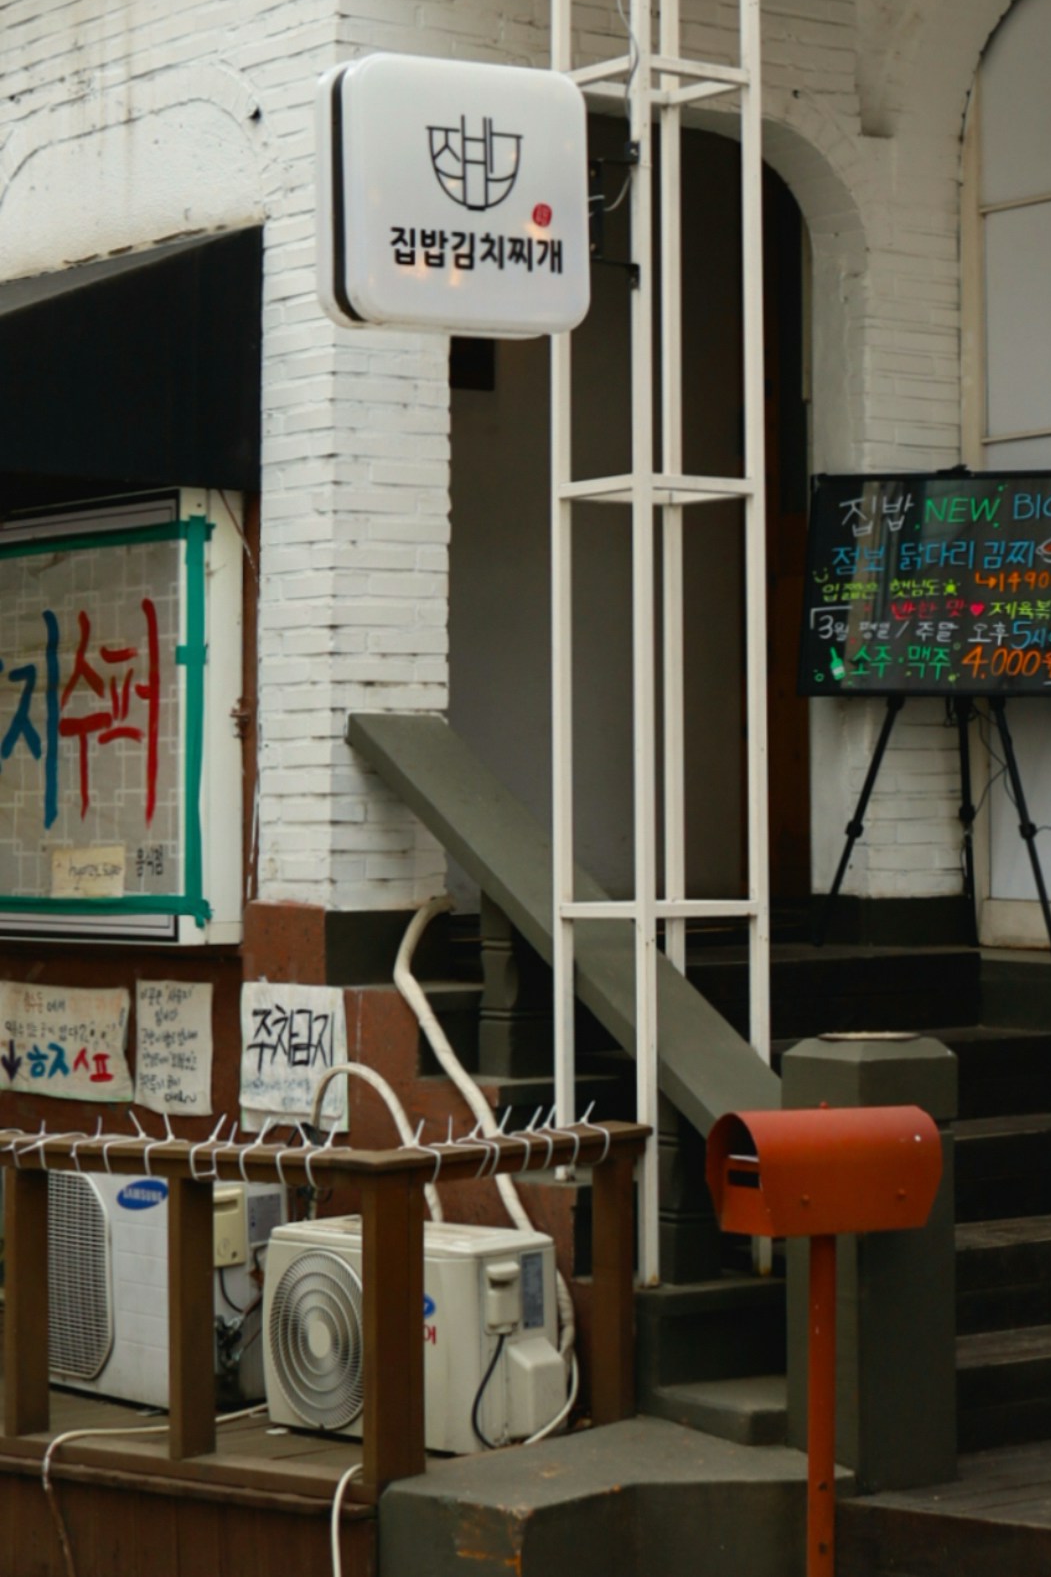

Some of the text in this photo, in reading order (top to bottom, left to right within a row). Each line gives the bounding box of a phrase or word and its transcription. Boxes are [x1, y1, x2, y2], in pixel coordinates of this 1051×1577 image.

[390, 227, 563, 274] 집밥김치찌개
[839, 493, 914, 537] 집밥
[924, 497, 1000, 523] NEW
[832, 540, 1035, 576] 점보 닭다리 김찌
[967, 622, 1010, 646] 오후
[0, 598, 159, 829] 지수퍼
[246, 1004, 336, 1074] 주차금지
